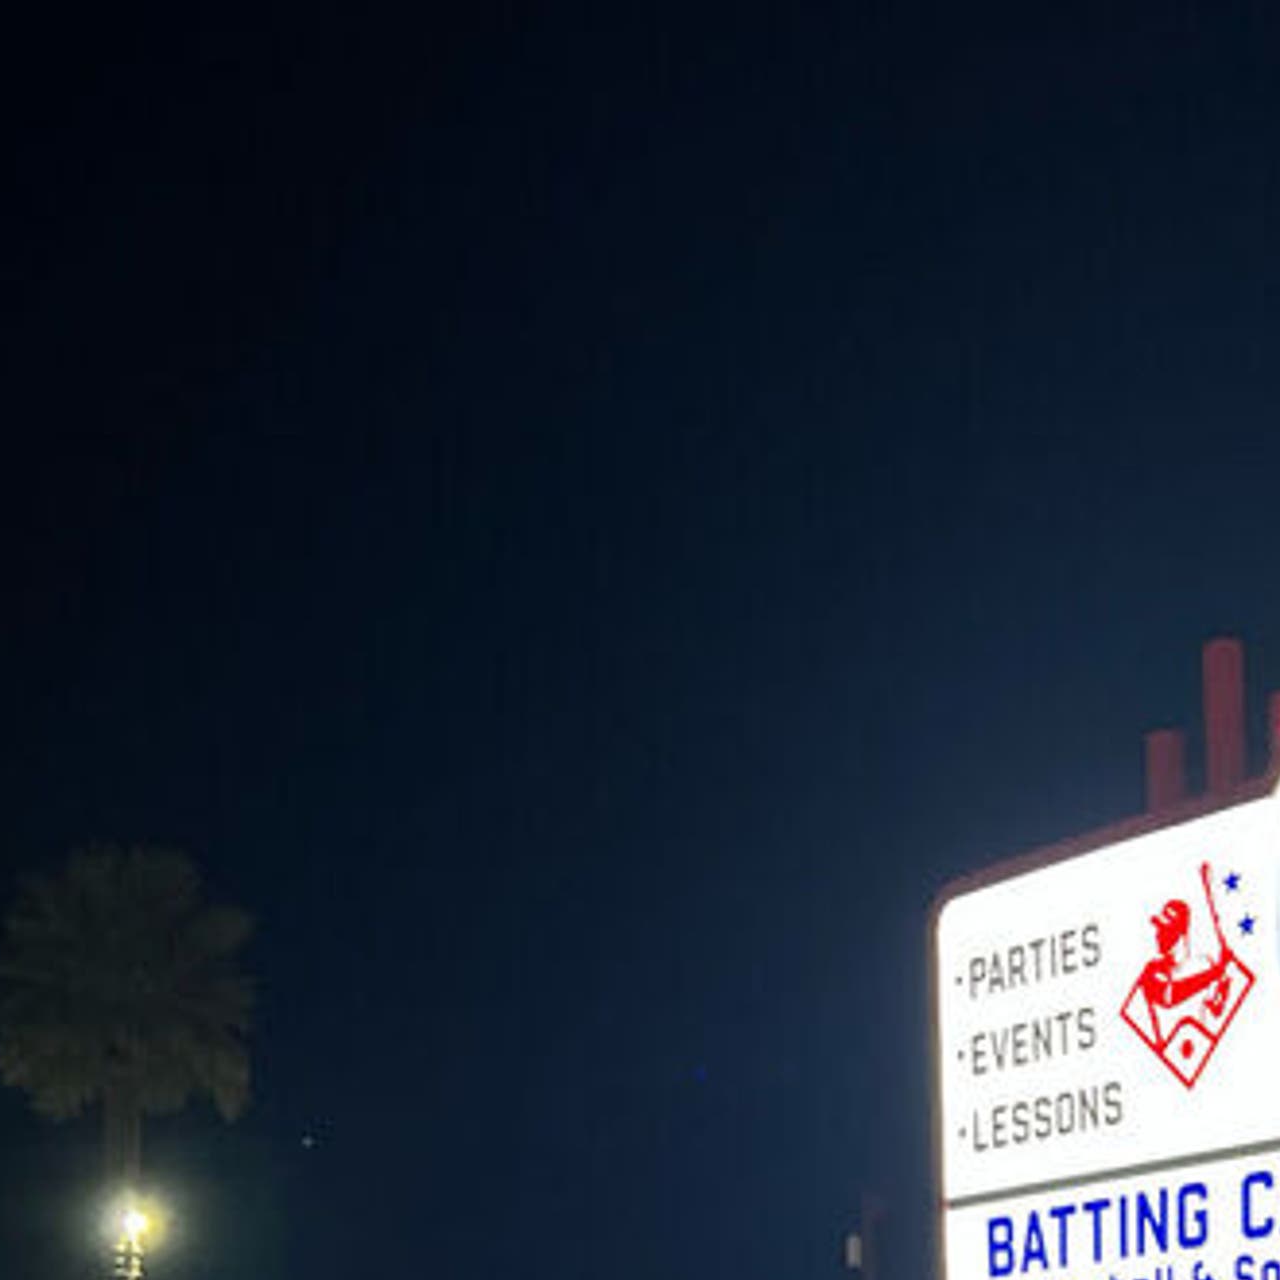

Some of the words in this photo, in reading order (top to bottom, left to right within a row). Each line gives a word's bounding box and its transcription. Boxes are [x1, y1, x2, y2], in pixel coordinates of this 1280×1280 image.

[968, 922, 1102, 999] PARTIES
[972, 1007, 1097, 1076] EVENTS
[973, 1081, 1124, 1152] LESSONS
[987, 1181, 1209, 1278] BATTING
